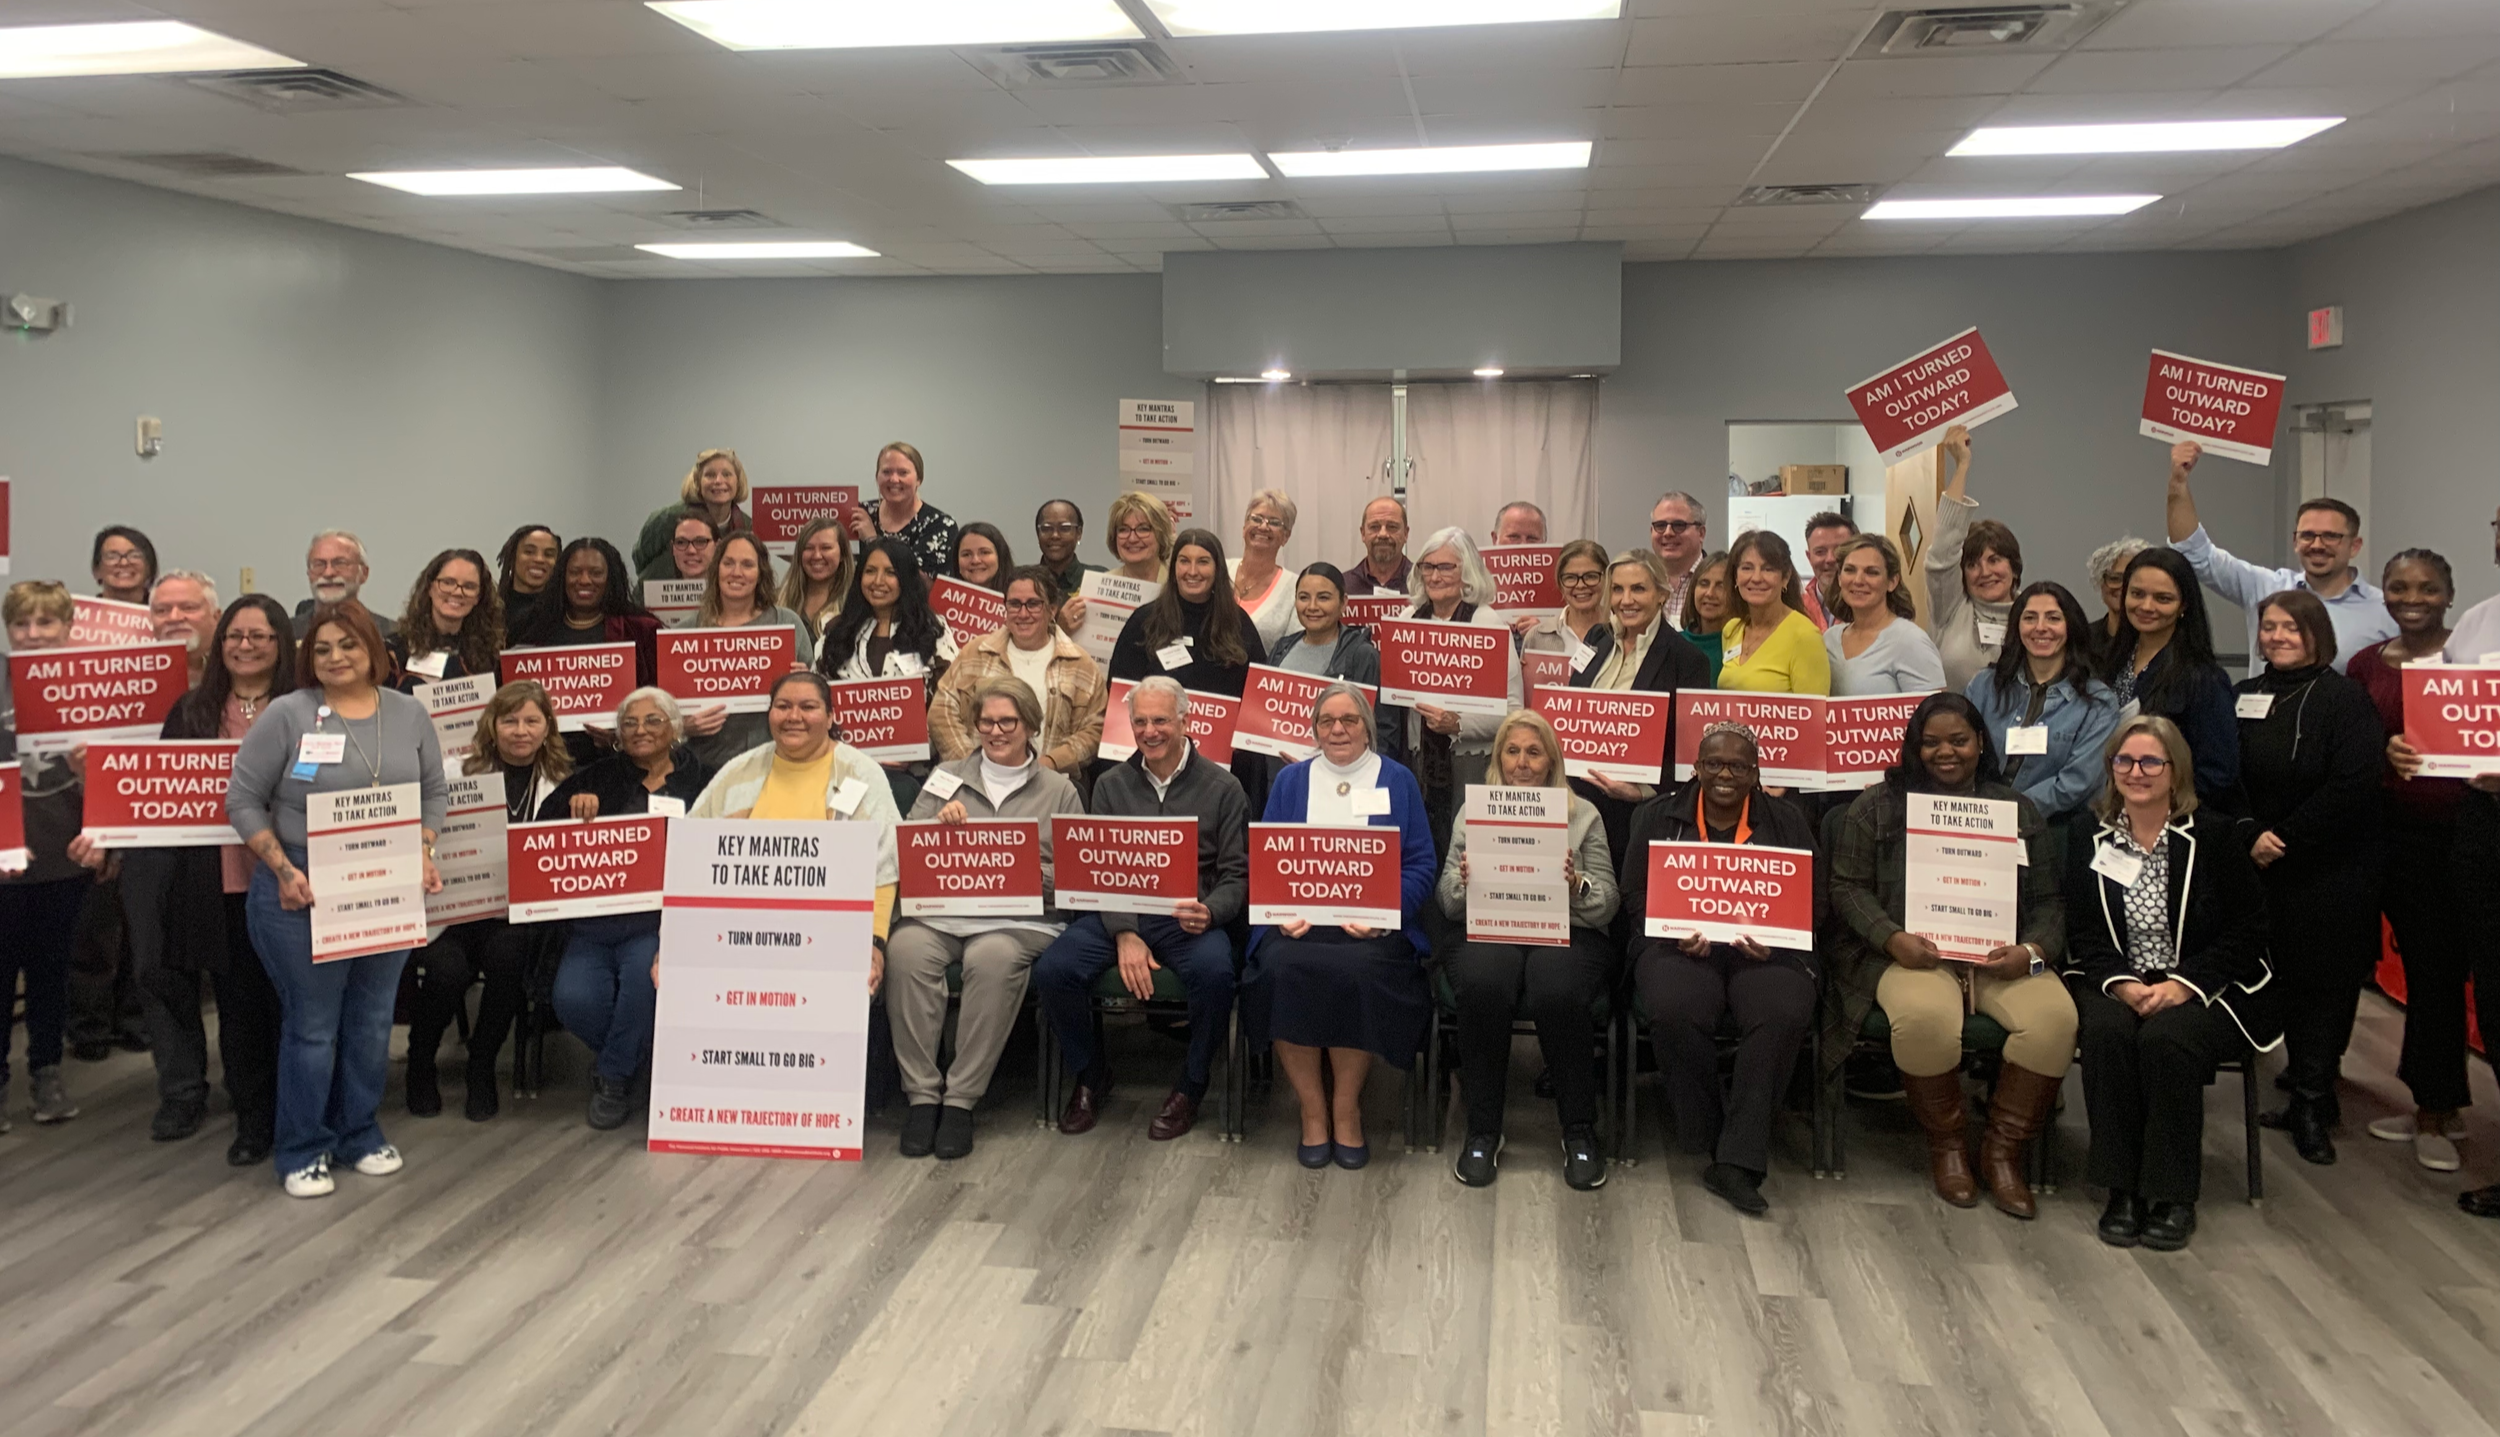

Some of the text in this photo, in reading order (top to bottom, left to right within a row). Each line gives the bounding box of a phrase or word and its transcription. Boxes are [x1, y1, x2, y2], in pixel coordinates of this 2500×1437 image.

[1867, 344, 1972, 406] AM I TURNED
[2159, 364, 2268, 398] AM I TURNED
[1885, 366, 1970, 417] OUTWARD
[1137, 404, 1174, 413] KEY MANTRAS
[1902, 390, 1969, 430] TODAY?
[2166, 386, 2251, 416] OUTWARD
[1135, 414, 1178, 423] TO TAKE ACTION
[2172, 407, 2236, 434] TODAY?
[762, 491, 848, 504] AM I TURNED
[771, 508, 839, 522] OUTWARD
[1490, 554, 1553, 568] TURNED
[675, 583, 703, 591] MANTRAS
[1101, 577, 1141, 592] KEY MANTRAS
[661, 594, 684, 603] TO TAKE
[941, 588, 975, 607] AM I
[1097, 587, 1142, 603] TO TAKE ACTION
[95, 609, 102, 624] I
[1363, 605, 1367, 617] I
[671, 636, 782, 654] AM I TURNED
[1392, 629, 1496, 650] AM I TURNED
[26, 654, 172, 679] AM I TURNED
[515, 653, 623, 674] AM I TURNED
[683, 656, 771, 673] OUTWARD
[1401, 649, 1483, 669] OUTWARD
[1535, 661, 1562, 676] AM
[432, 681, 474, 696] KEY MANTRAS
[693, 675, 761, 692] TODAY?
[1257, 677, 1293, 695] AM I
[1409, 670, 1473, 689] TODAY?
[2423, 678, 2478, 696] AM I
[43, 678, 157, 702] OUTWARD
[837, 686, 912, 705] I TURNED
[432, 692, 479, 708] TO TAKE ACTION
[1544, 697, 1655, 717] AM I TURNED
[56, 701, 145, 724] TODAY?
[1690, 701, 1812, 720] AM I TURNED
[1842, 709, 1847, 723] I
[1553, 717, 1640, 737] OUTWARD
[1561, 738, 1628, 757] TODAY?
[102, 753, 138, 771] AM
[146, 753, 151, 770] I
[117, 778, 229, 795] OUTWARD
[335, 792, 392, 807] KEY MANTRAS
[457, 793, 483, 804] ACTION
[1490, 791, 1541, 803] KEY MANTRAS
[130, 801, 218, 819] TODAY?
[333, 805, 397, 823] TO TAKE ACTION
[1487, 804, 1545, 817] TO TAKE ACTION
[1933, 800, 1989, 815] KEY MANTRAS
[1931, 814, 1994, 829] TO TAKE ACTION
[523, 826, 651, 851] AM I TURNED
[911, 830, 1026, 847] AM I TURNED
[1066, 826, 1184, 845] AM I TURNED
[718, 835, 819, 858] KEY MANTRAS
[1264, 836, 1386, 854] AM I TURNED
[1942, 847, 1982, 858] TURN OUTWARD
[538, 849, 638, 872] OUTWARD
[925, 852, 1015, 868] OUTWARD
[1079, 848, 1171, 868] OUTWARD
[1664, 854, 1796, 876] AM I TURNED
[712, 864, 826, 888] TO TAKE ACTION
[1277, 859, 1373, 877] OUTWARD
[550, 871, 627, 893] TODAY?
[936, 874, 1005, 890] TODAY?
[1090, 870, 1159, 890] TODAY?
[1677, 875, 1782, 897] OUTWARD
[1943, 876, 1981, 887] GET IN MOTION
[1288, 882, 1363, 899] TODAY?
[1688, 897, 1769, 918] TODAY?
[1931, 904, 1992, 918] START SMALL TO GO BIG
[727, 930, 801, 947] TURN OUTWARD
[726, 991, 796, 1007] GET IN MOTION
[702, 1050, 815, 1068] START SMALL TO GO BIG
[670, 1107, 840, 1129] CREATE A NEW TRAJECTORY OF HOPE
